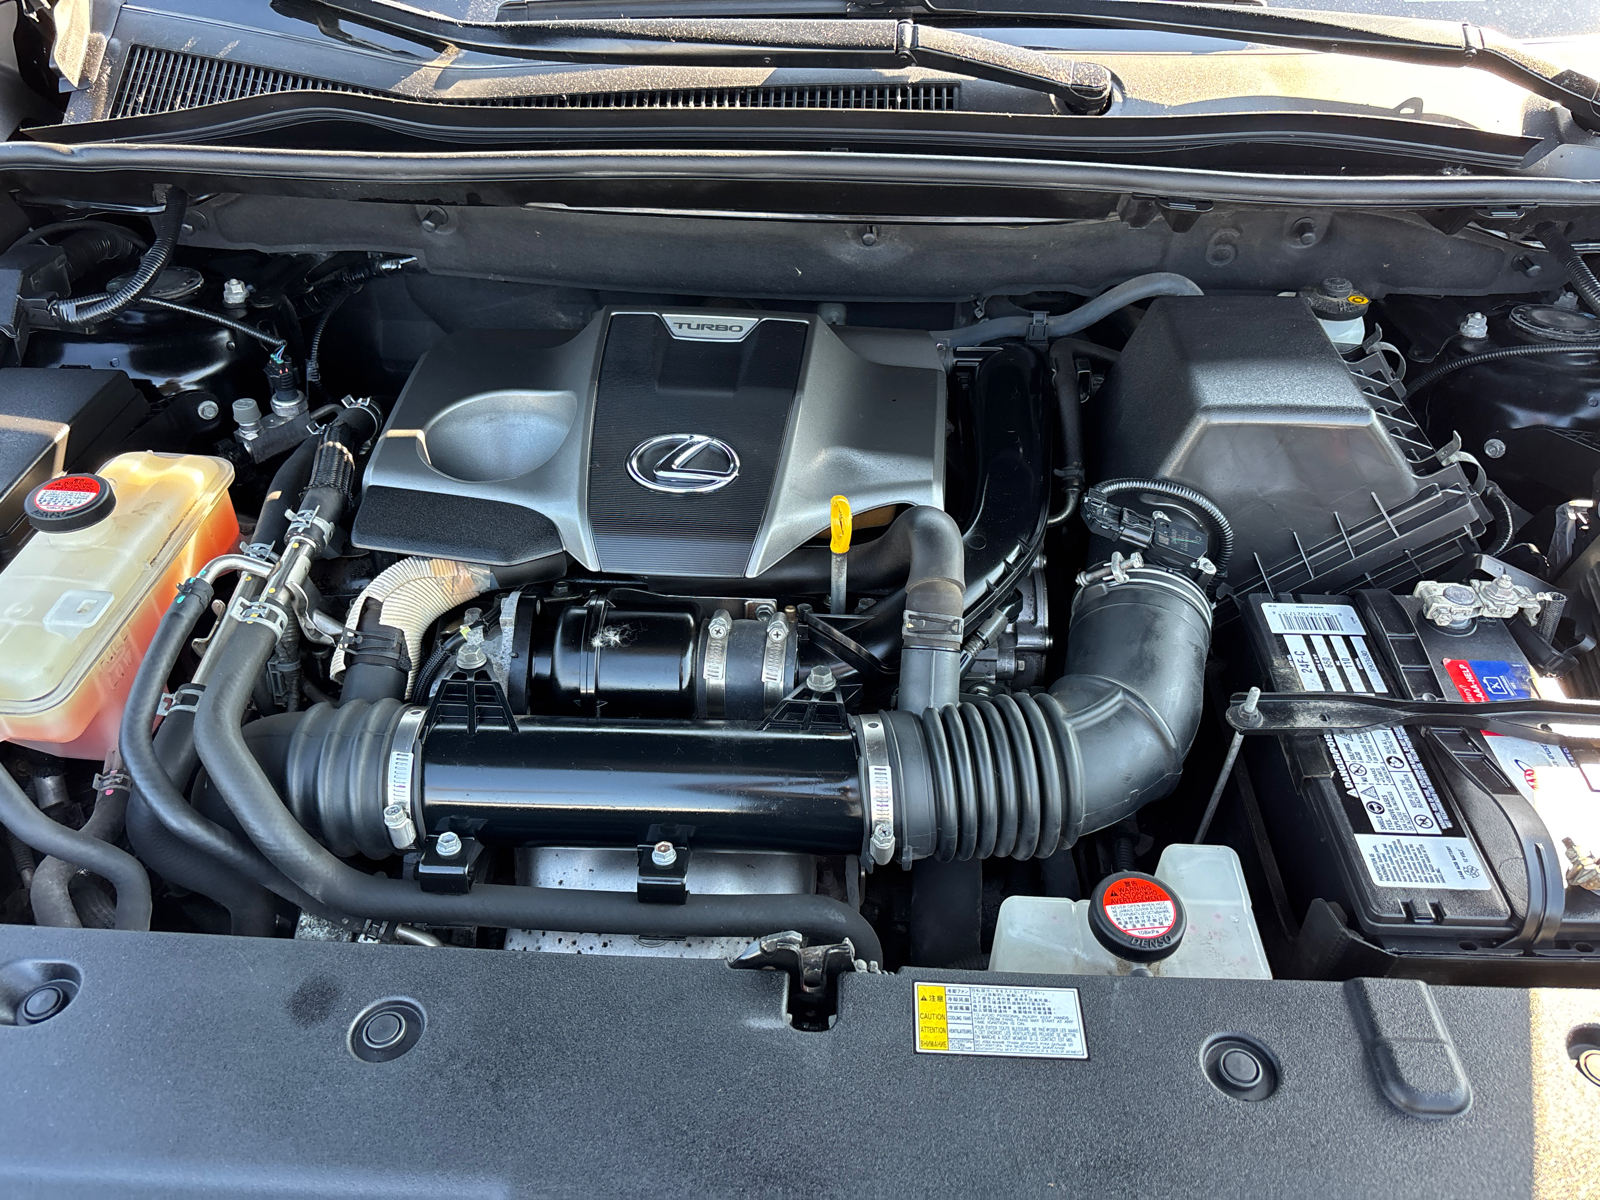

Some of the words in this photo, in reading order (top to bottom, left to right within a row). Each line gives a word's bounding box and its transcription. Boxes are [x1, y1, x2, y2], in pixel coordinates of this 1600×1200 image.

[1206, 227, 1241, 266] 6
[674, 322, 743, 332] TURBO
[1293, 651, 1312, 672] 24F-C
[1321, 657, 1333, 667] 650
[1341, 658, 1352, 667] 110
[1459, 664, 1485, 702] -AAA-HELP
[1323, 734, 1354, 787] DANGER/POIS
[1111, 895, 1162, 905] AVERTISSEMENT
[1130, 934, 1172, 948] DENSO
[920, 1040, 947, 1048] ВНИМАНИЕ
